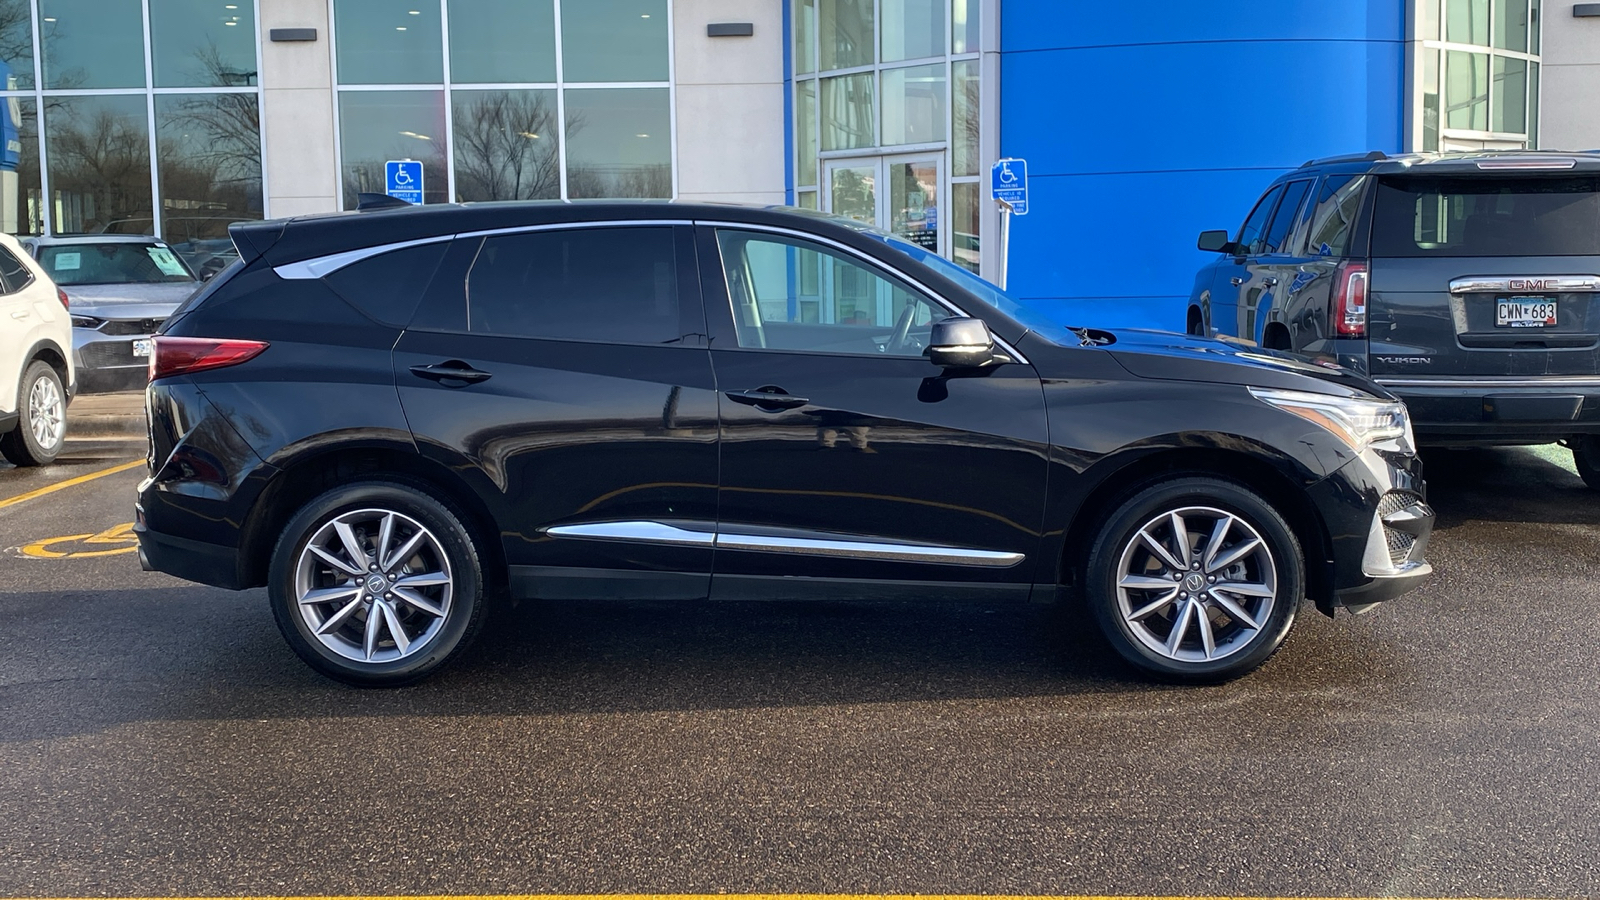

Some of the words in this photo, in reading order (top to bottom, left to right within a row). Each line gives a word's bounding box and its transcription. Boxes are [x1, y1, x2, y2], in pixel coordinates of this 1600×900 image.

[1507, 279, 1559, 291] GMC
[1499, 303, 1522, 319] CWN
[1531, 303, 1555, 319] 683
[1376, 356, 1431, 364] YUKON
